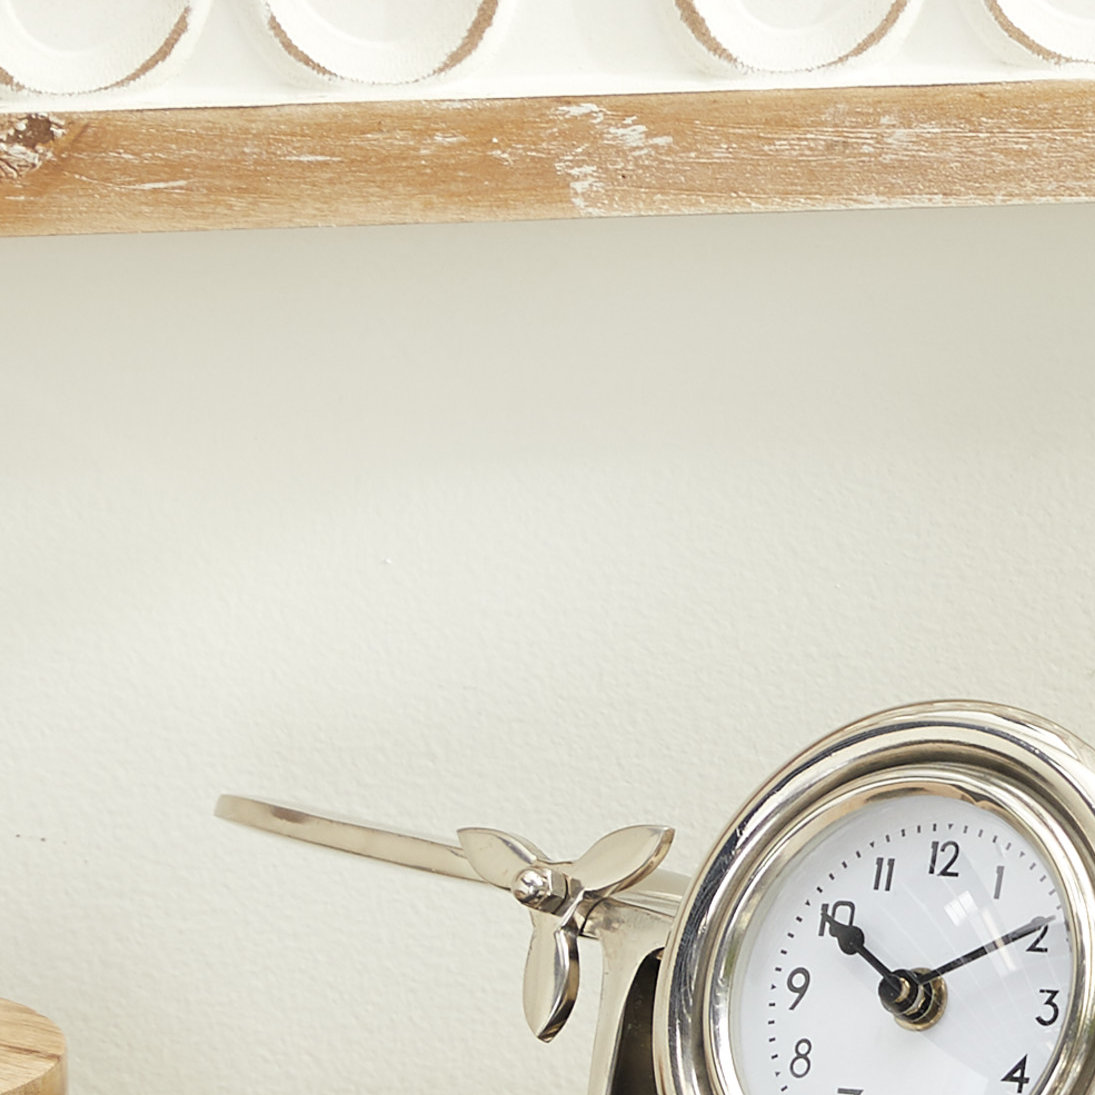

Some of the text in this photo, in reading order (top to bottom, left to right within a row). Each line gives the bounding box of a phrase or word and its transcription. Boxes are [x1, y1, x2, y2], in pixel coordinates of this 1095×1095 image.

[872, 856, 896, 892] 11
[928, 840, 960, 877] 12
[993, 865, 1005, 900] 1
[817, 899, 857, 937] 10
[1025, 916, 1050, 953] 2
[785, 966, 812, 1011] 9
[1034, 988, 1060, 1027] 3
[788, 1037, 813, 1079] 8
[1000, 1053, 1031, 1095] 4
